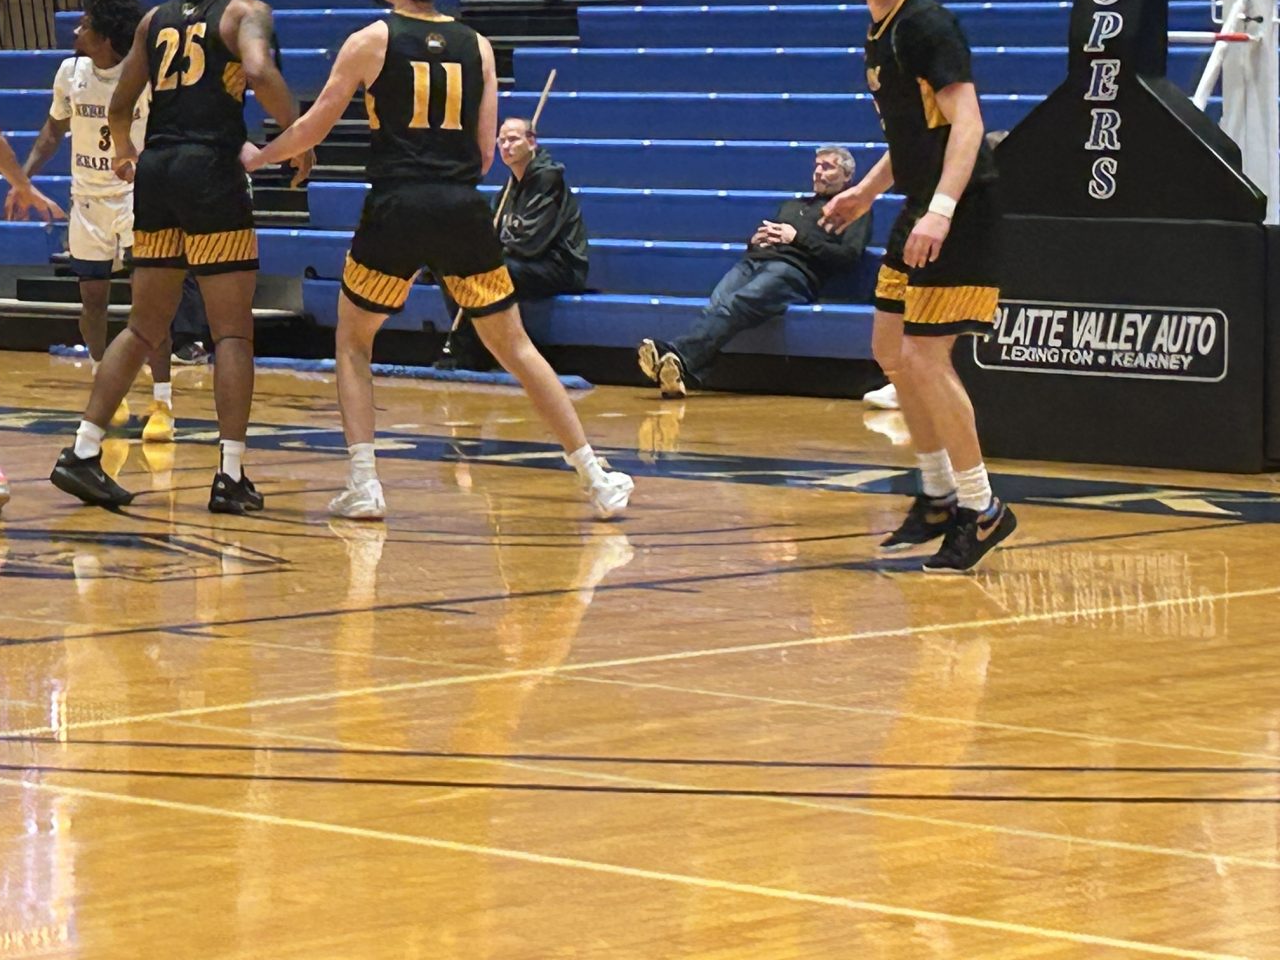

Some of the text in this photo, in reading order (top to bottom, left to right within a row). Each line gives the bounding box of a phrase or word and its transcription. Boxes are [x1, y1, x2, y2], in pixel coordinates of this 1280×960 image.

[154, 22, 207, 92] 25
[408, 61, 464, 131] 11
[98, 125, 111, 152] 3
[1070, 309, 1153, 352] VALLEY
[1151, 314, 1217, 356] AUTO
[1000, 344, 1194, 372] LEXINGTON KEARNEY
